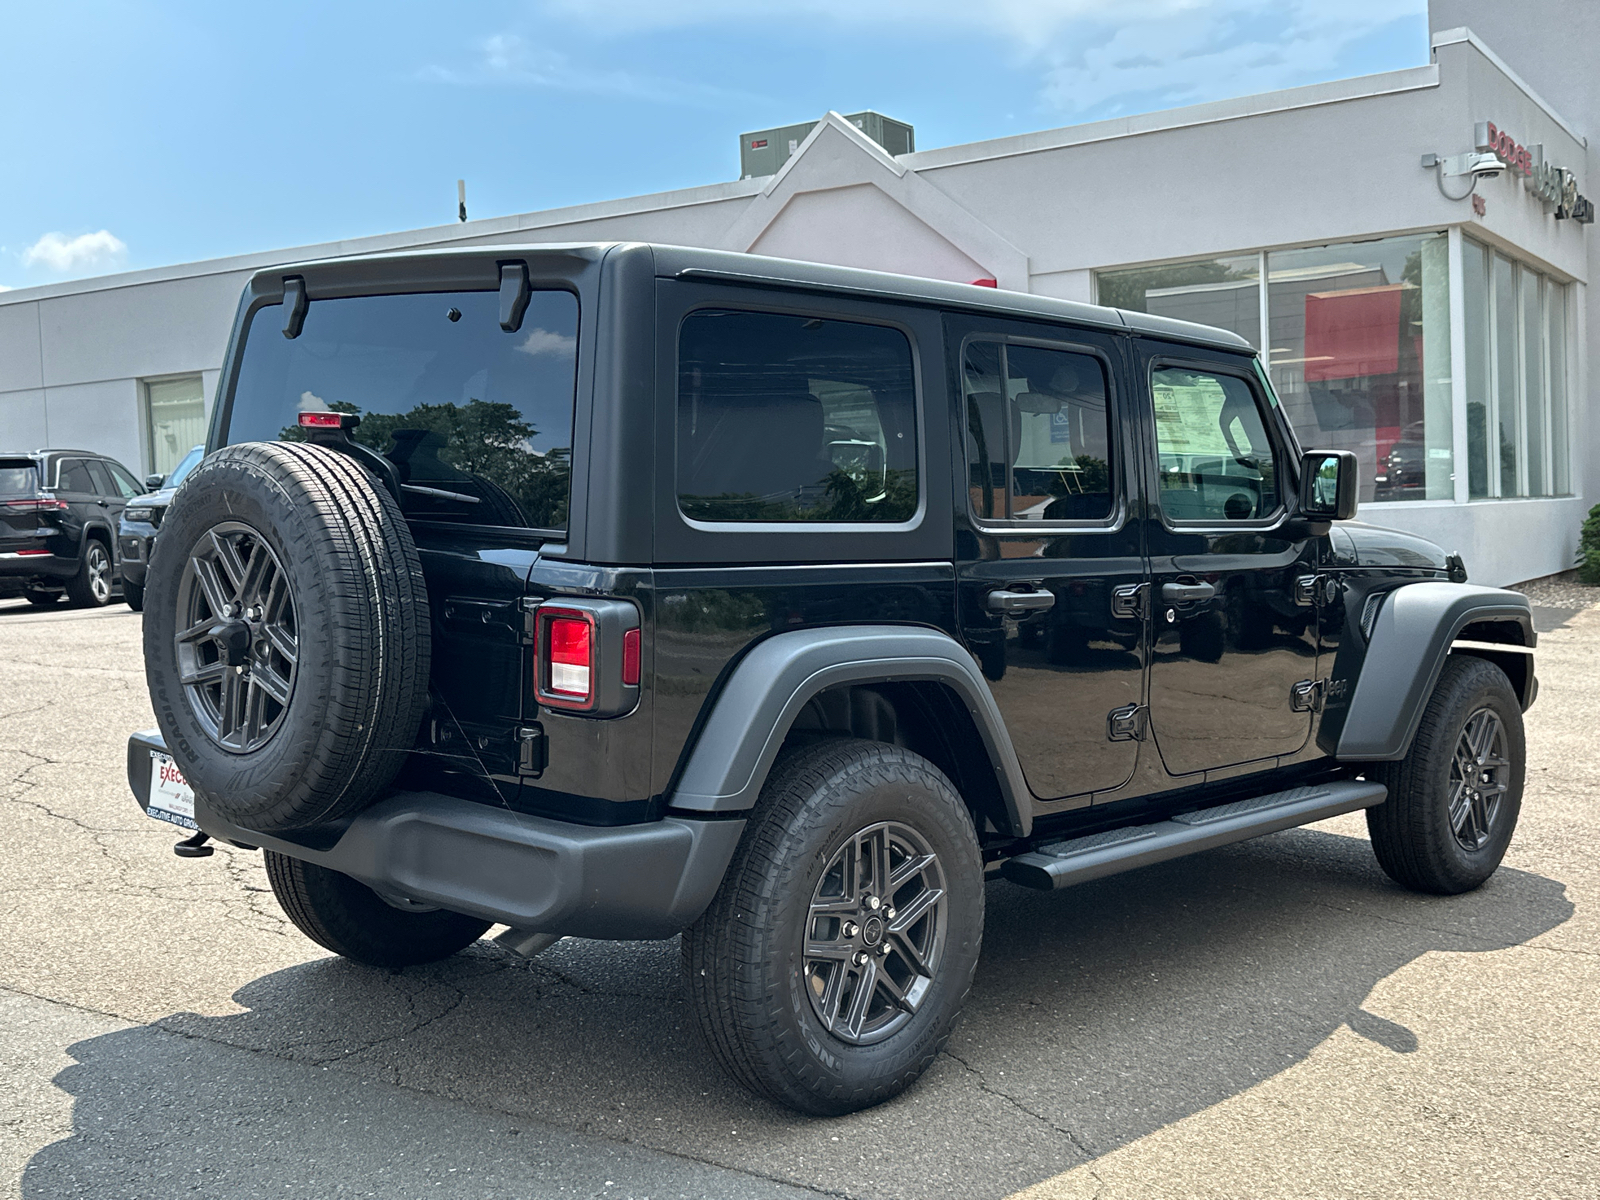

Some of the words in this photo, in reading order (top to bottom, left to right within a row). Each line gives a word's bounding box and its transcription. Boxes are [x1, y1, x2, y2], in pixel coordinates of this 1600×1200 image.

[1487, 121, 1533, 177] DODGE
[1322, 677, 1347, 699] Jeep
[153, 669, 200, 764] ROADIAN
[146, 807, 171, 822] EXECUTIVE
[171, 813, 183, 825] AUTO
